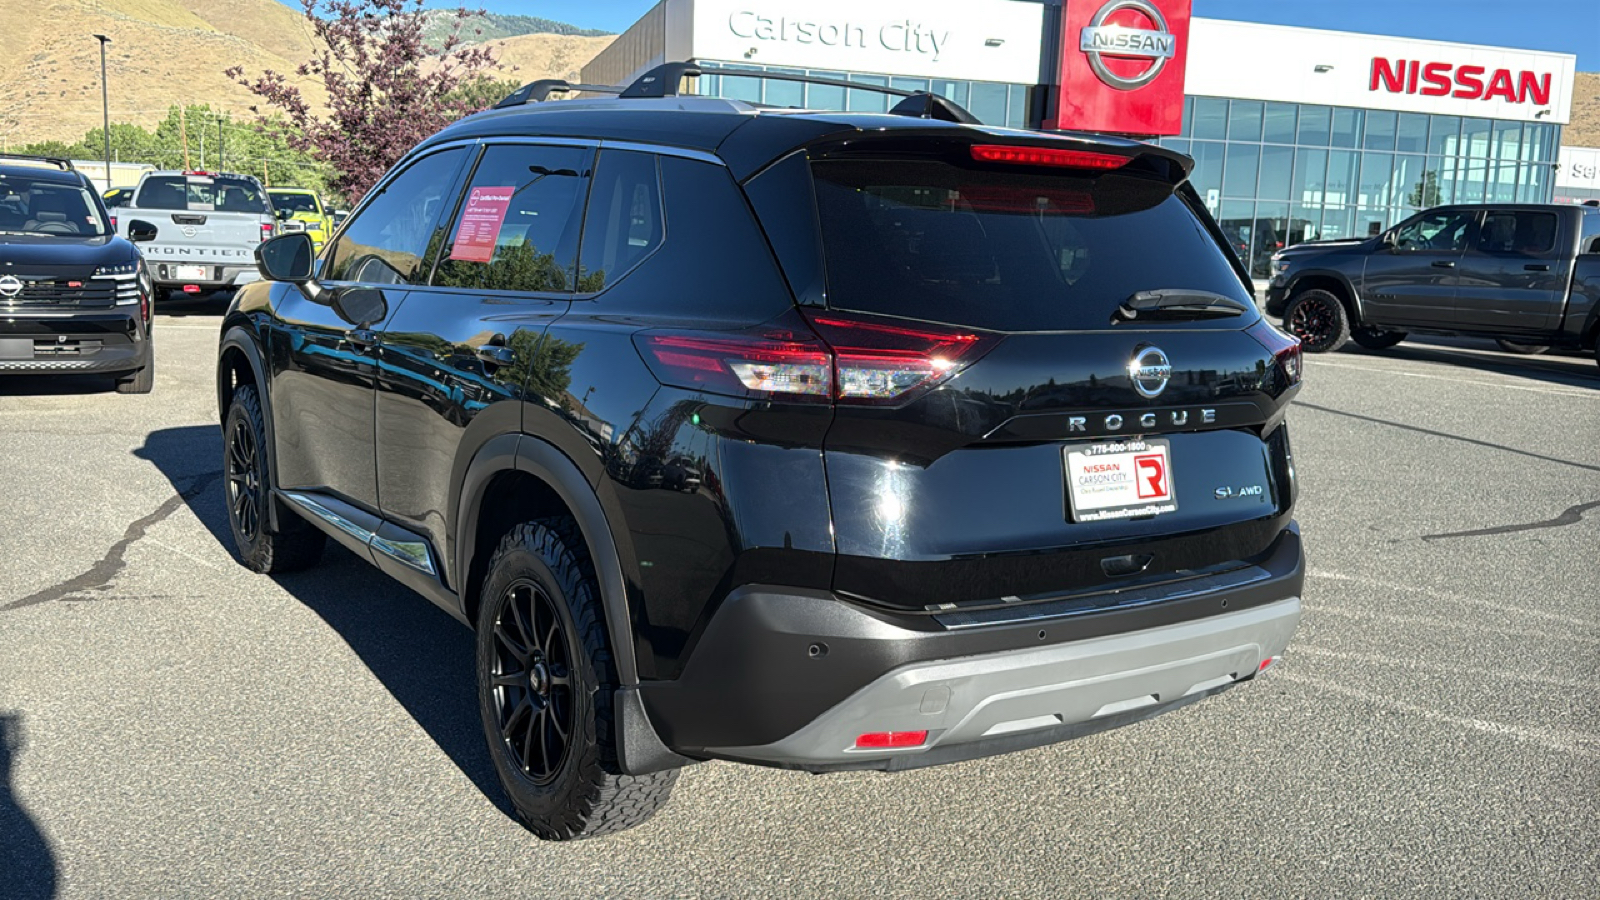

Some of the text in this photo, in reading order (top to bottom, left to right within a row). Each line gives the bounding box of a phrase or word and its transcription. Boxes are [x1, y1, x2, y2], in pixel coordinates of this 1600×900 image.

[728, 11, 951, 62] Carson City
[1092, 31, 1169, 52] NISSAN
[1369, 56, 1552, 106] NISSAN
[1571, 162, 1600, 179] Ser
[1068, 408, 1217, 432] ROGUE
[1083, 463, 1120, 474] NISSAN
[1079, 472, 1127, 486] CARSON CITY
[1214, 485, 1262, 499] SL AWD
